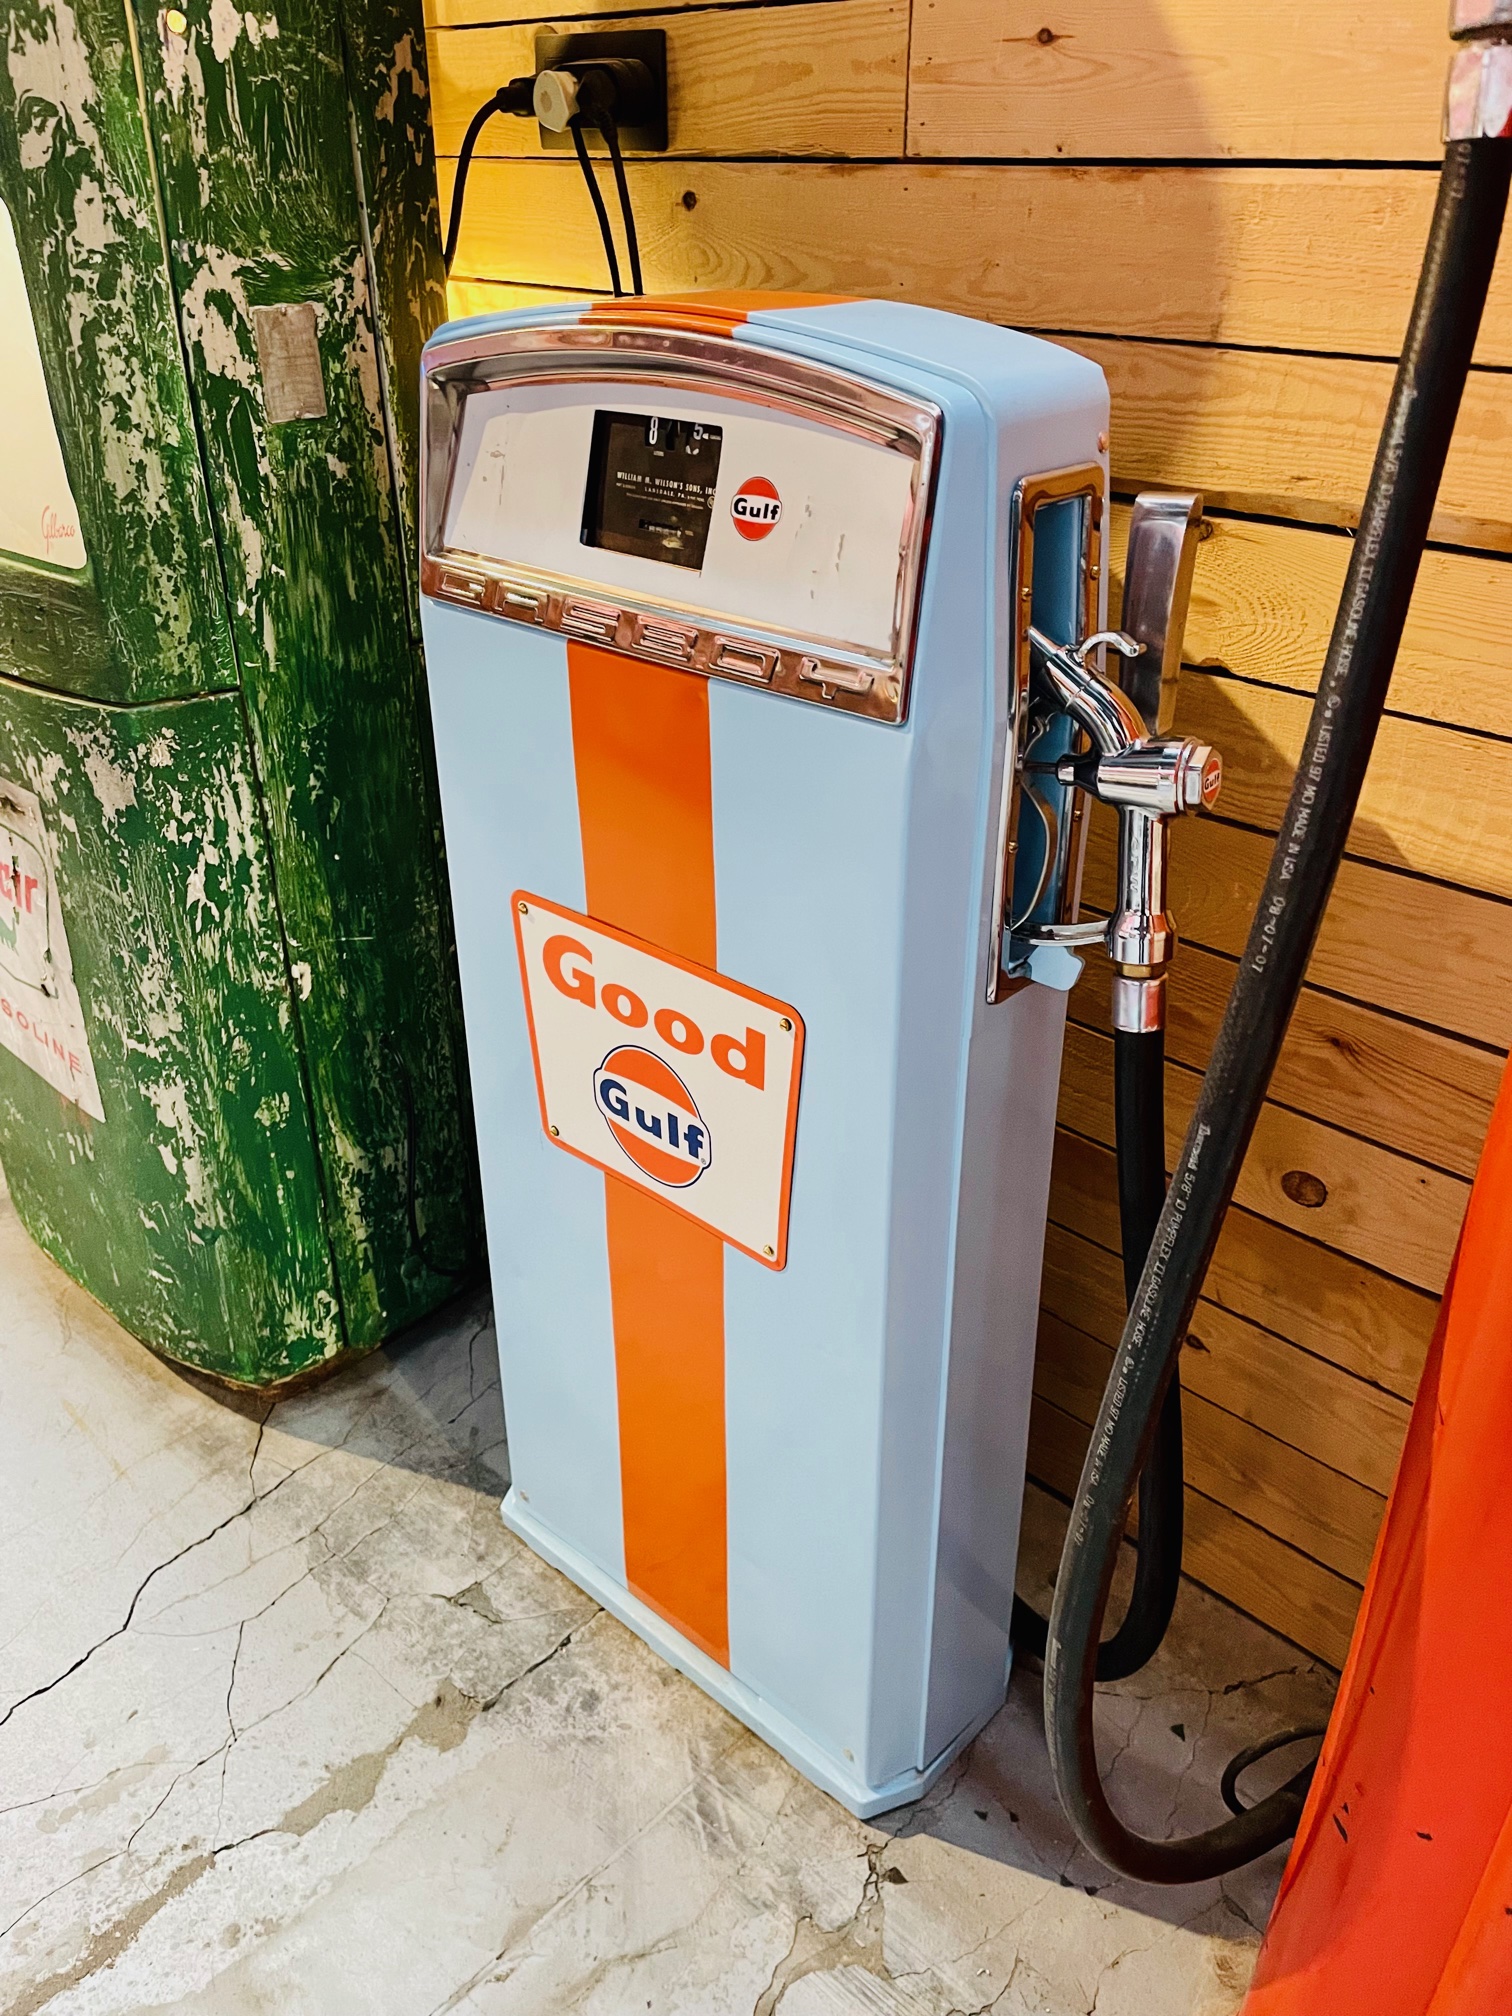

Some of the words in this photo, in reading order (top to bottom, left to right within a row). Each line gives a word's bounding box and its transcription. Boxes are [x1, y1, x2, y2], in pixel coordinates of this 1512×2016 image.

[616, 471, 643, 482] WILLIAM
[654, 478, 684, 490] WILSON'S
[685, 483, 703, 495] SONS,
[733, 498, 780, 521] Gulf
[438, 564, 876, 700] GASBOY
[1336, 643, 1353, 678] HOSE
[1314, 723, 1332, 763] LISTED
[1309, 764, 1322, 781] 97
[1303, 783, 1317, 804] MO
[1293, 806, 1310, 839] MADE
[1288, 842, 1300, 854] IN
[1280, 856, 1296, 882] USA
[542, 935, 766, 1092] Good
[600, 1078, 704, 1160] Gulf
[1161, 1211, 1183, 1261] PUMPFLEX
[1142, 1275, 1161, 1321] GASOLINE
[1133, 1320, 1147, 1347] HOSE
[1114, 1377, 1128, 1407] LISTED
[1105, 1417, 1116, 1435] MO
